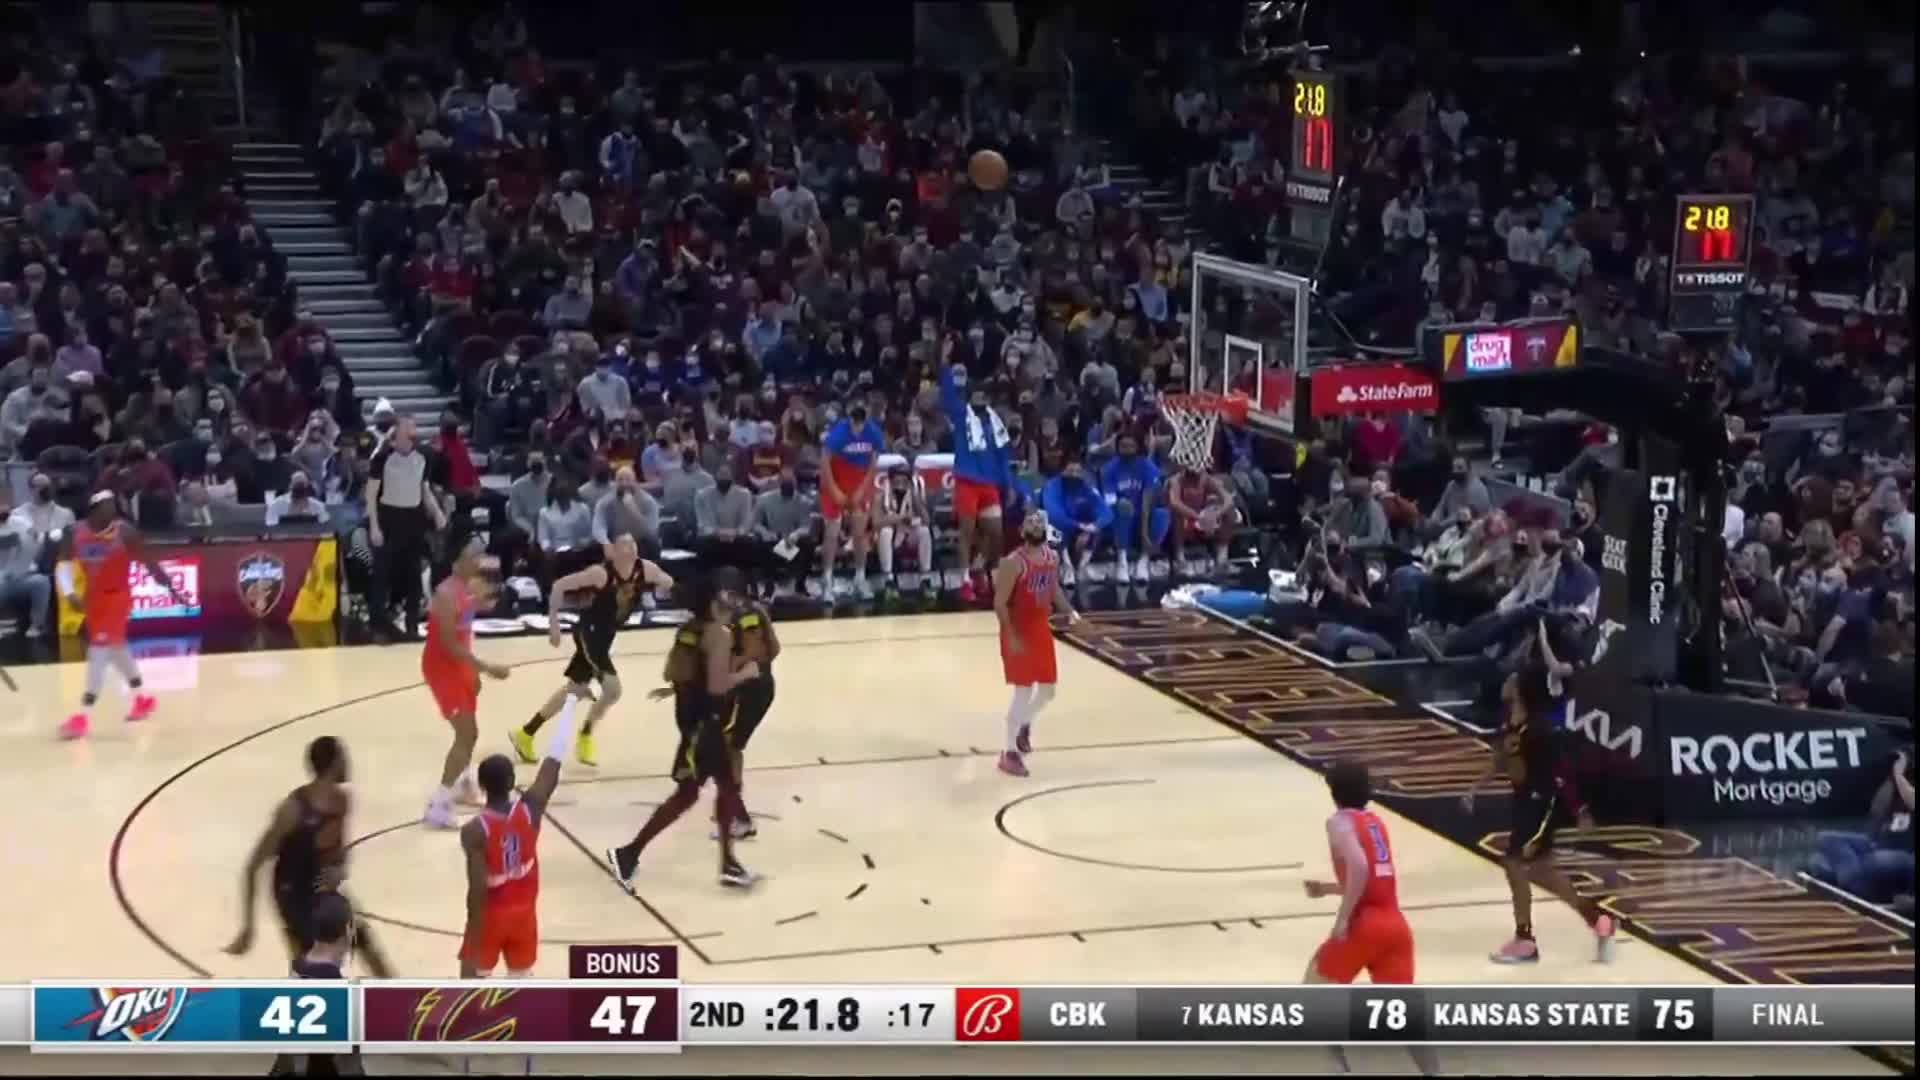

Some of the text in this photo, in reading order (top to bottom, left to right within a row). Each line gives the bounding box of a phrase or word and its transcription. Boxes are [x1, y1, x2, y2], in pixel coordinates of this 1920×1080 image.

[1695, 272, 1744, 284] TISSOT
[1470, 336, 1504, 353] drug
[1649, 503, 1669, 625] Cleveland Clinic
[1670, 727, 1867, 775] ROCKET
[1713, 777, 1832, 805] Mortgage
